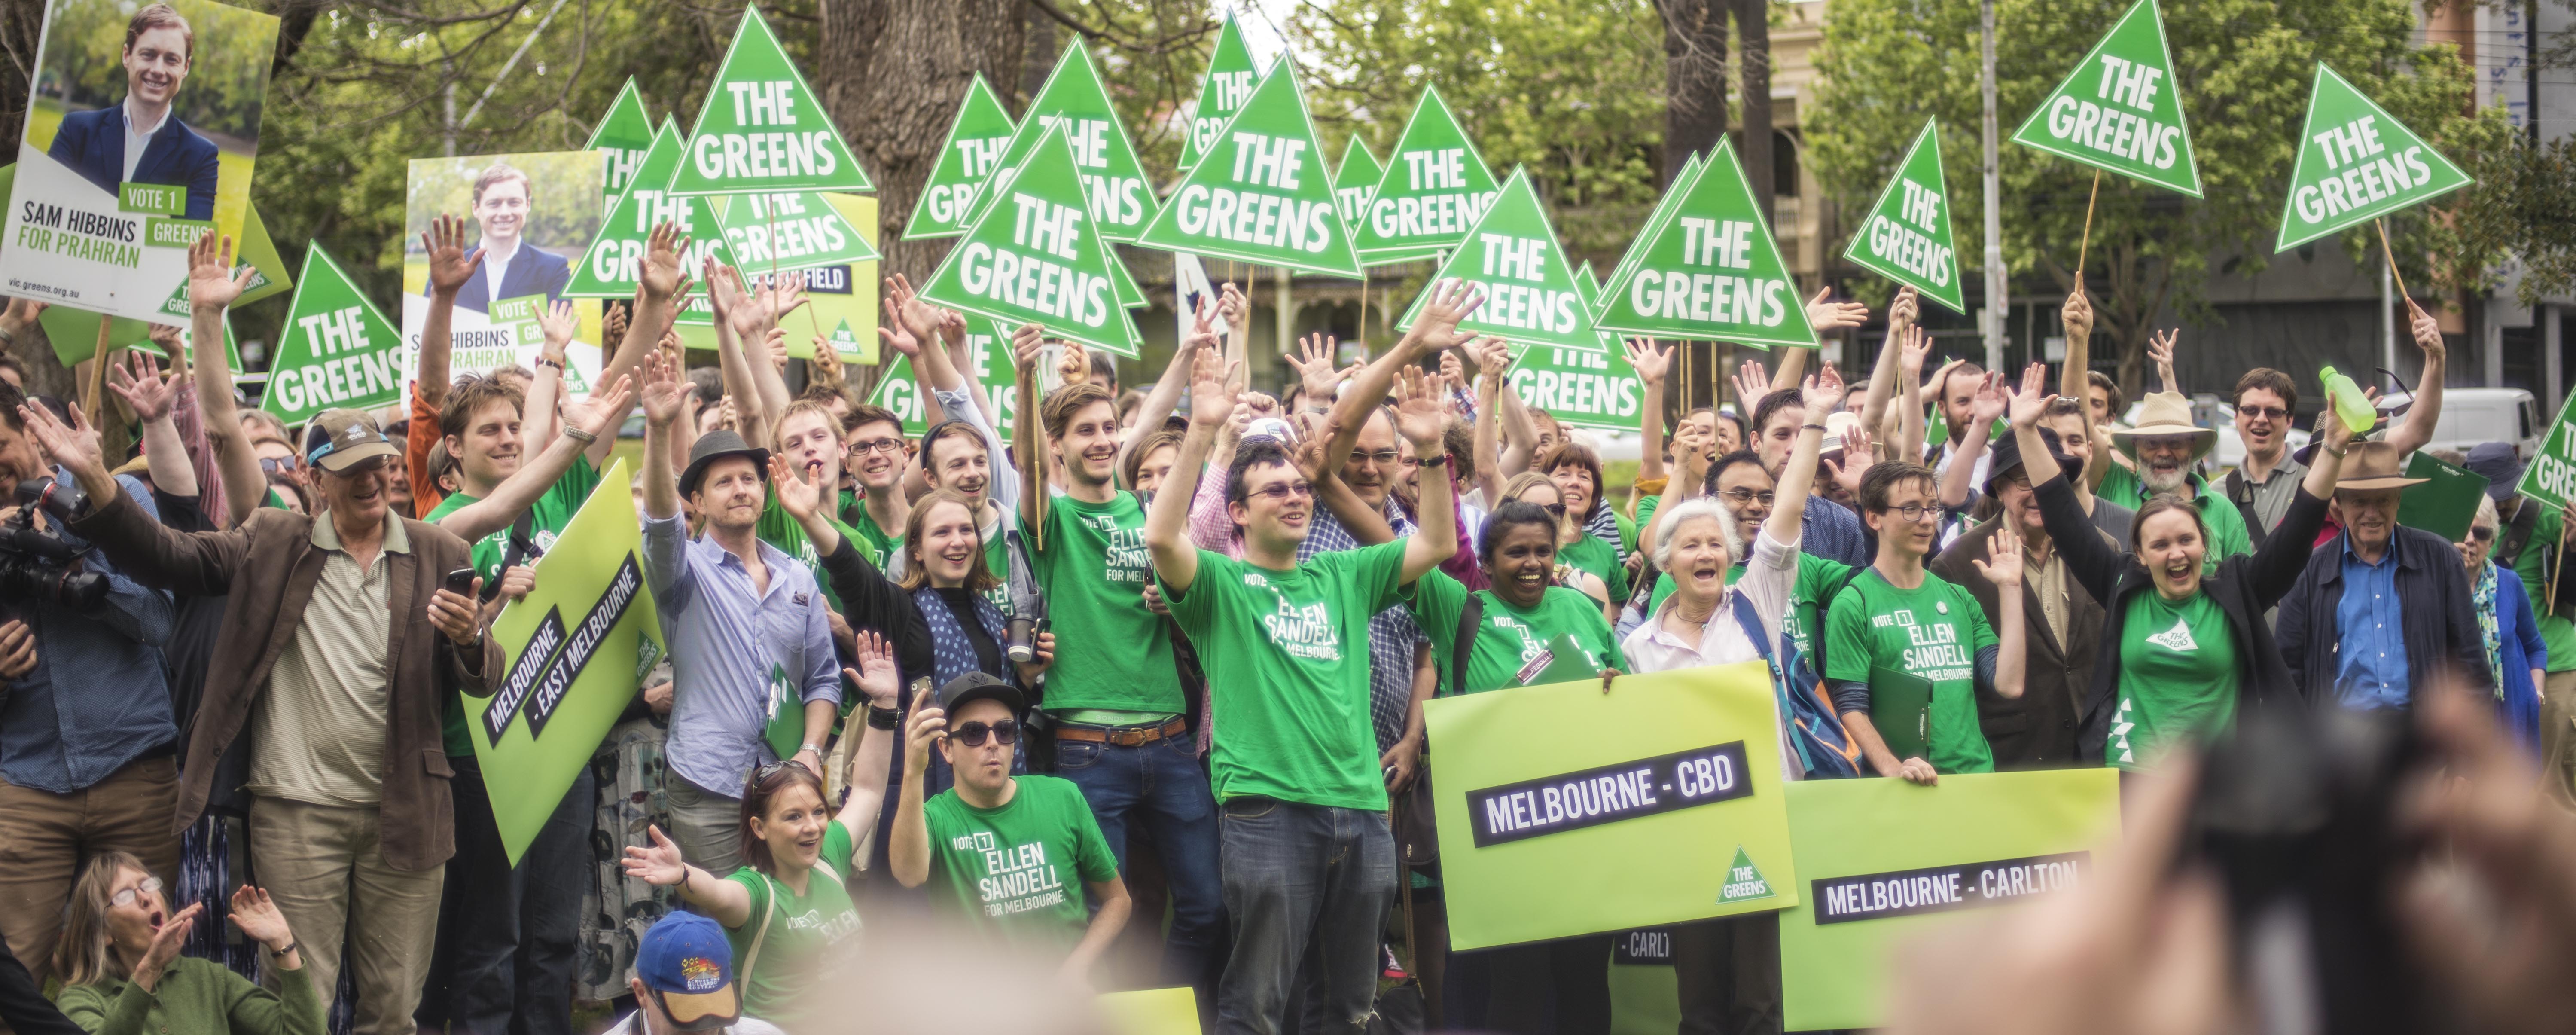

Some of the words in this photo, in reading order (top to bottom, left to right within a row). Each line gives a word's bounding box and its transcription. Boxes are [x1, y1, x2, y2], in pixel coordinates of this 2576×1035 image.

[1213, 70, 1252, 110] THE
[2097, 54, 2163, 113] THE
[727, 81, 796, 126] THE
[2049, 95, 2180, 170] GREENS
[2313, 115, 2385, 170] THE
[695, 131, 836, 179] GREENS
[1232, 132, 1306, 190] THE
[1404, 148, 1466, 190] THE
[128, 188, 163, 209] VOTE
[169, 192, 176, 210] 1
[1338, 185, 1376, 220] TH
[2295, 146, 2431, 225] GREENS
[22, 200, 63, 228] SAM
[67, 209, 136, 243] HIBBINS
[634, 190, 695, 233] THE
[1177, 184, 1332, 253] GREENS
[1901, 177, 1941, 235] THE
[726, 215, 846, 265] GREENS
[1013, 192, 1083, 261] THE
[1680, 217, 1753, 269] THE
[17, 225, 52, 253] FOR
[55, 232, 140, 269] PRAHRAN
[1480, 232, 1547, 282] THE
[1870, 215, 1951, 288] GREENS
[9, 278, 80, 299] vic.greens.org.au
[960, 242, 1109, 327] GREENS
[1631, 269, 1785, 327] GREENS
[168, 299, 191, 314] GRE
[496, 301, 528, 319] VOTE
[297, 306, 370, 358] THE
[836, 330, 851, 341] THE
[564, 368, 575, 379] HE
[1510, 368, 1637, 417] GREENS
[2537, 453, 2576, 503] GRE
[1105, 519, 1111, 528] 1
[1111, 528, 1146, 551] ELLE
[1106, 546, 1153, 568] SANDE
[1107, 569, 1124, 581] FOR
[1244, 574, 1267, 587] VOTE
[537, 659, 568, 716] EAST
[566, 564, 636, 672] MELBOURNE
[1265, 614, 1338, 646] SANDELL
[1872, 614, 1894, 628] VOTE
[1902, 614, 1908, 623] 1
[1908, 623, 1956, 646] ELLEN
[639, 638, 650, 658] THE
[1903, 644, 1972, 670] SANDELL
[2157, 635, 2188, 647] GREENS
[490, 619, 558, 733] MELBOURNE
[637, 644, 656, 677] GREENS
[1926, 668, 1972, 681] MELBOURNE
[1486, 768, 1656, 834] MELBOURNE
[1677, 754, 1734, 797] CBD
[953, 836, 974, 850] VOTE
[981, 837, 987, 848] 1
[986, 842, 1045, 875] ELLEN
[980, 865, 1062, 901] SANDELL
[1724, 880, 1766, 898] GREENS
[1732, 866, 1753, 881] THE
[1826, 873, 1962, 915] MELBOURNE
[1981, 860, 2078, 898] CARLTON
[786, 916, 807, 929] VOTE
[984, 903, 1003, 917] FOR
[1630, 931, 1669, 958] CARLT
